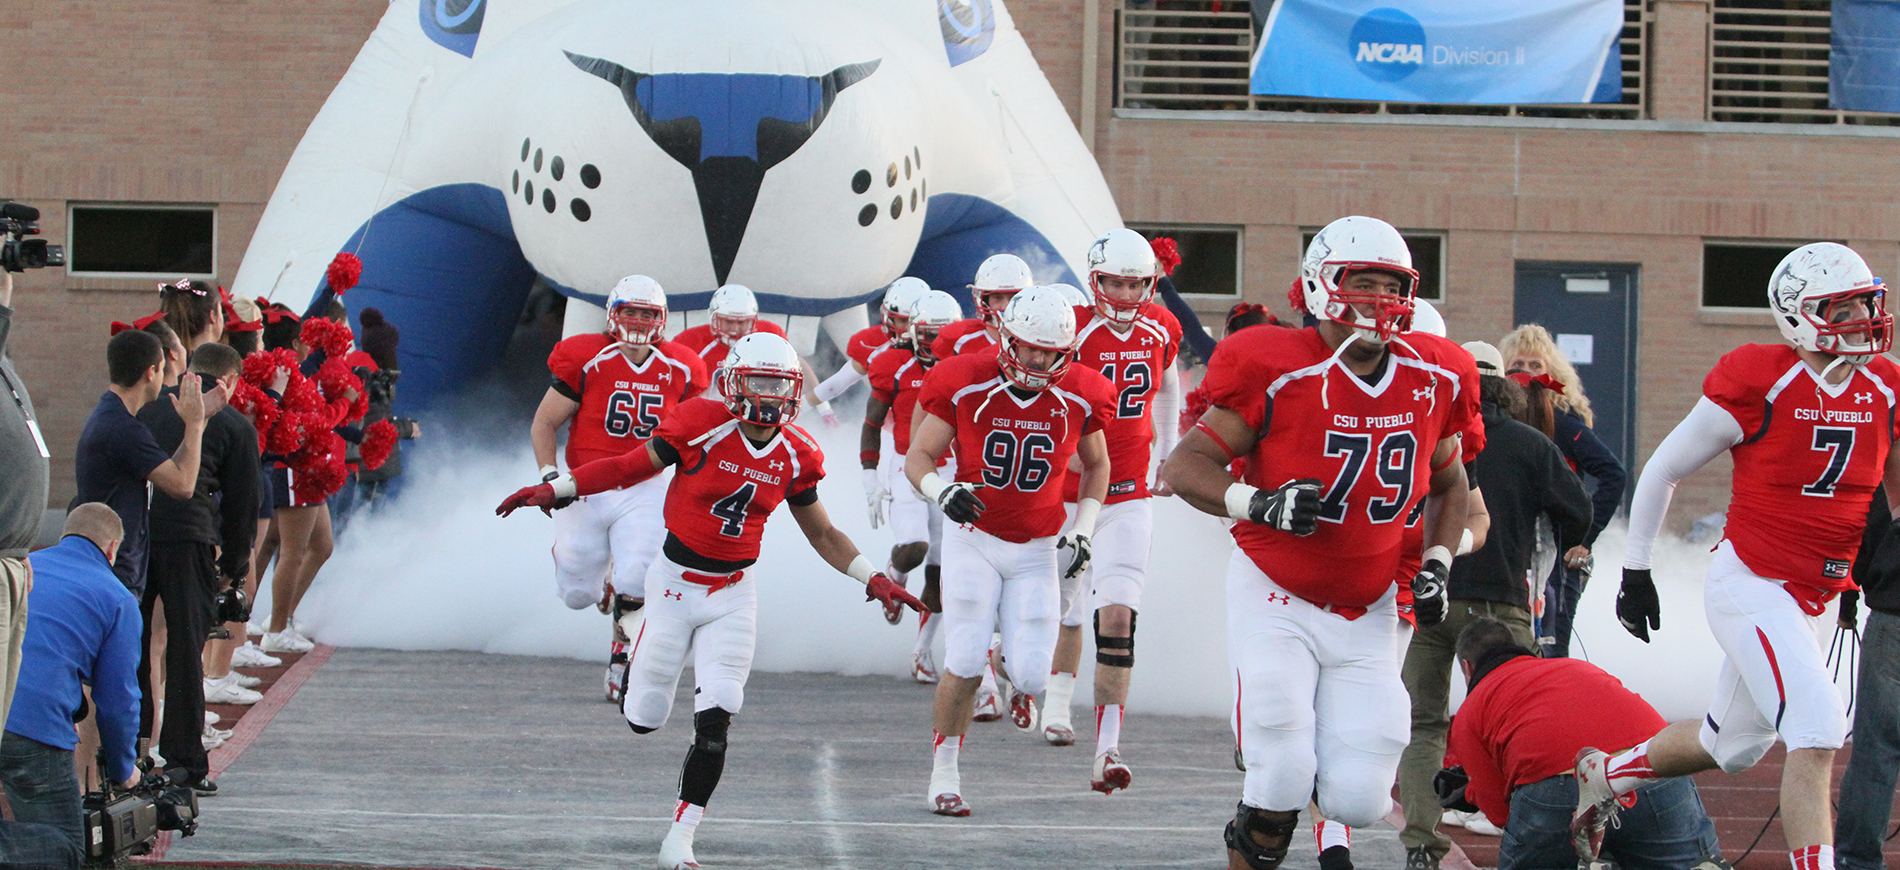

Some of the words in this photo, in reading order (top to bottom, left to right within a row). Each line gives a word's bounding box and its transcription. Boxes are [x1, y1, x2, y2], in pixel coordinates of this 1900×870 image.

[1355, 41, 1423, 64] NCAA
[1432, 45, 1509, 65] Division
[1100, 352, 1116, 361] CSU
[1120, 350, 1151, 360] PUEBLO
[614, 380, 630, 389] CSU
[631, 382, 660, 392] PUEBLO
[911, 379, 923, 387] CS
[604, 390, 664, 440] 65
[992, 417, 1011, 428] CSU
[1014, 420, 1051, 431] PUEBLO
[1333, 414, 1358, 428] CSU
[1365, 412, 1414, 428] PUEBLO
[1794, 408, 1820, 420] CSU
[1826, 410, 1873, 423] PUEBLO
[980, 429, 1055, 492] 96
[1801, 425, 1856, 497] 7
[718, 460, 740, 473] CSU
[742, 467, 781, 486] PUEBLO
[1316, 430, 1418, 524] 79
[709, 480, 758, 538] 4
